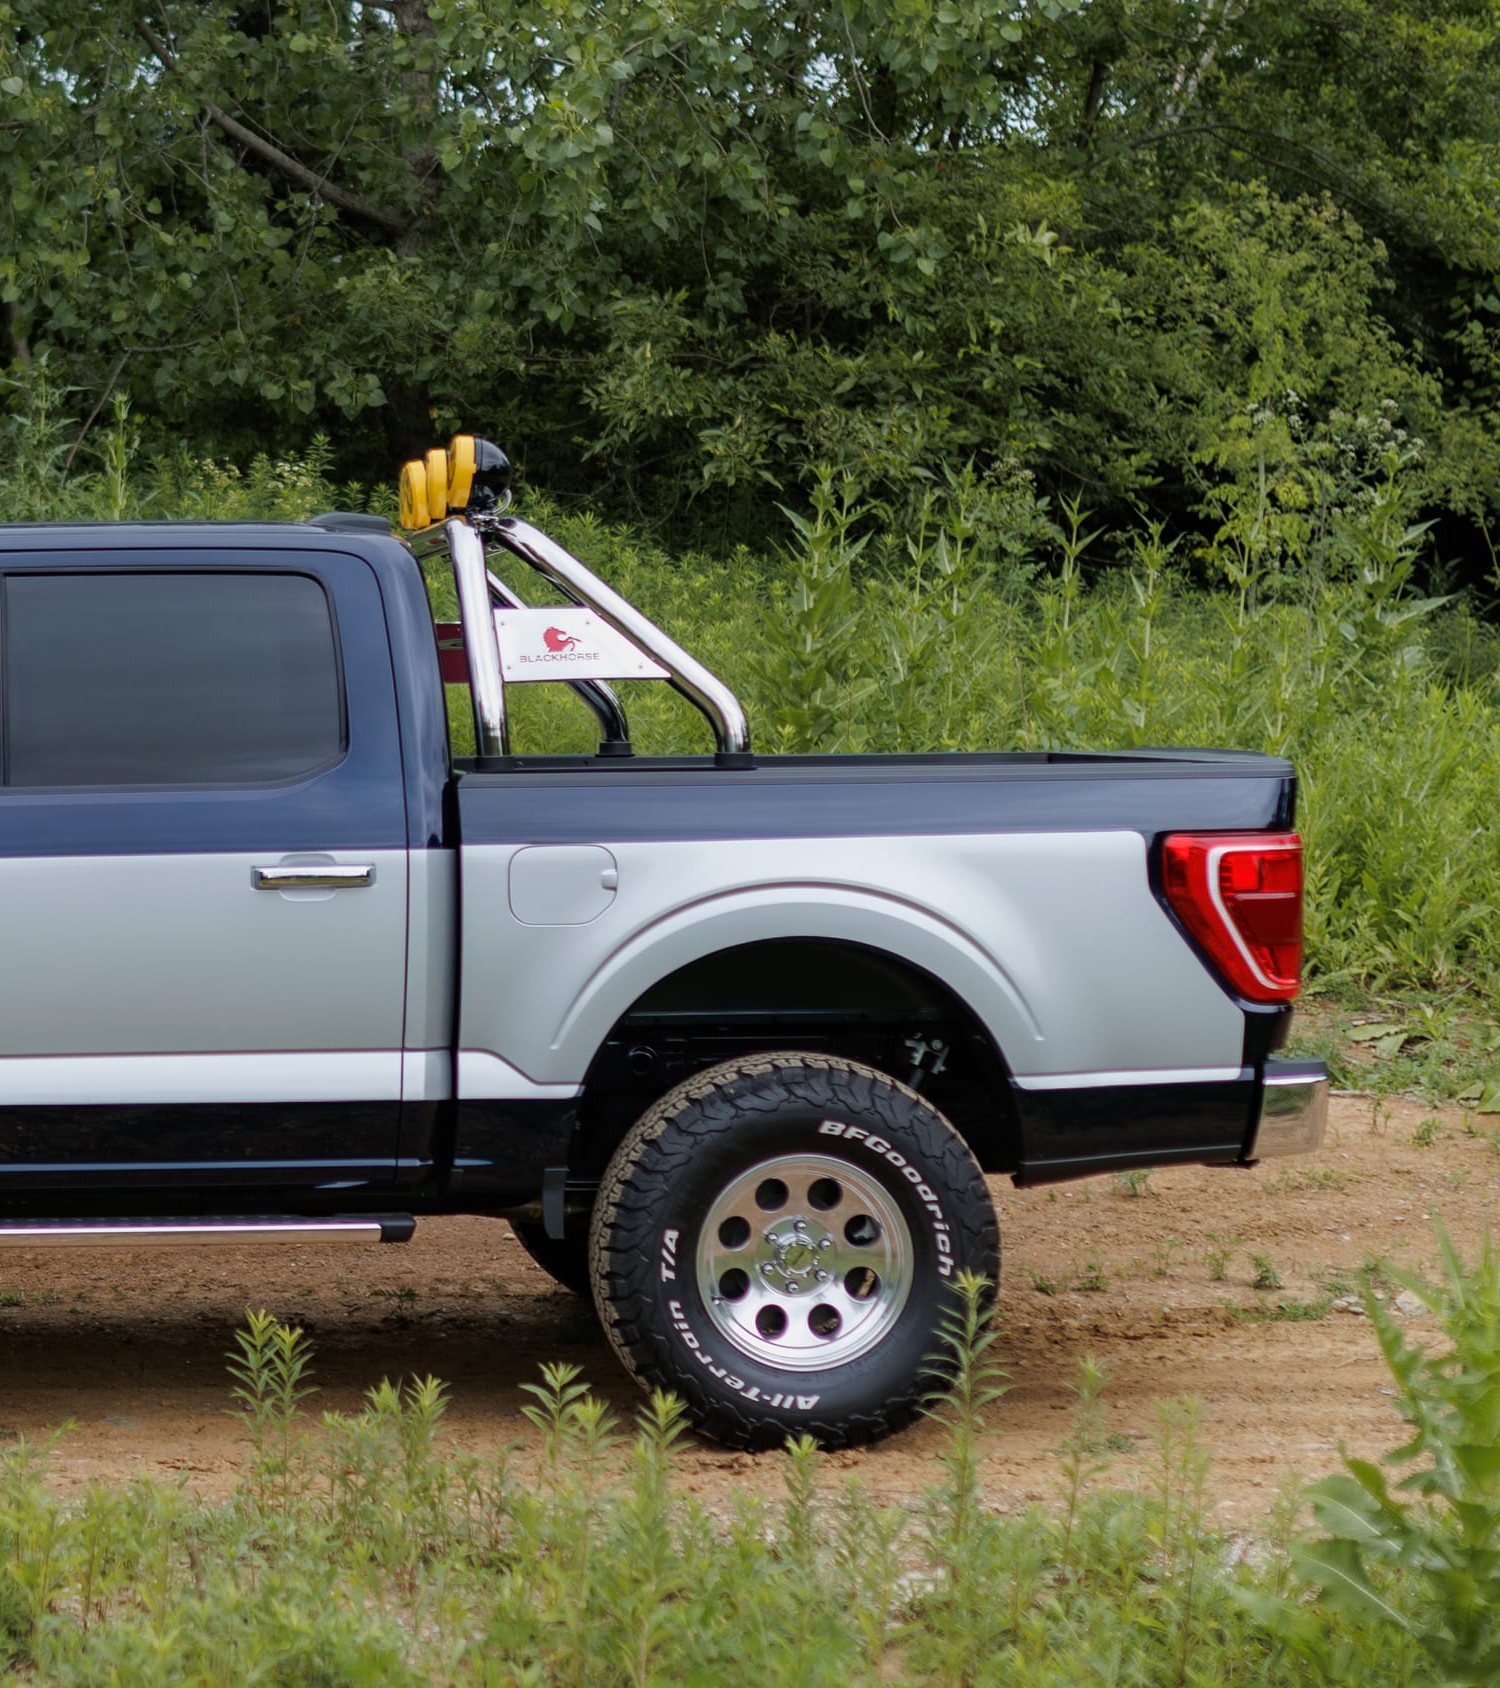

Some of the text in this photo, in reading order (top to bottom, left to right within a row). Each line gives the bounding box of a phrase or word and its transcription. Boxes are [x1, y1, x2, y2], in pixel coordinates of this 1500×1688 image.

[519, 652, 600, 663] BLACKHORSE
[818, 1120, 954, 1276] BFGoodrich
[660, 1229, 820, 1410] All-Terrain T/A
